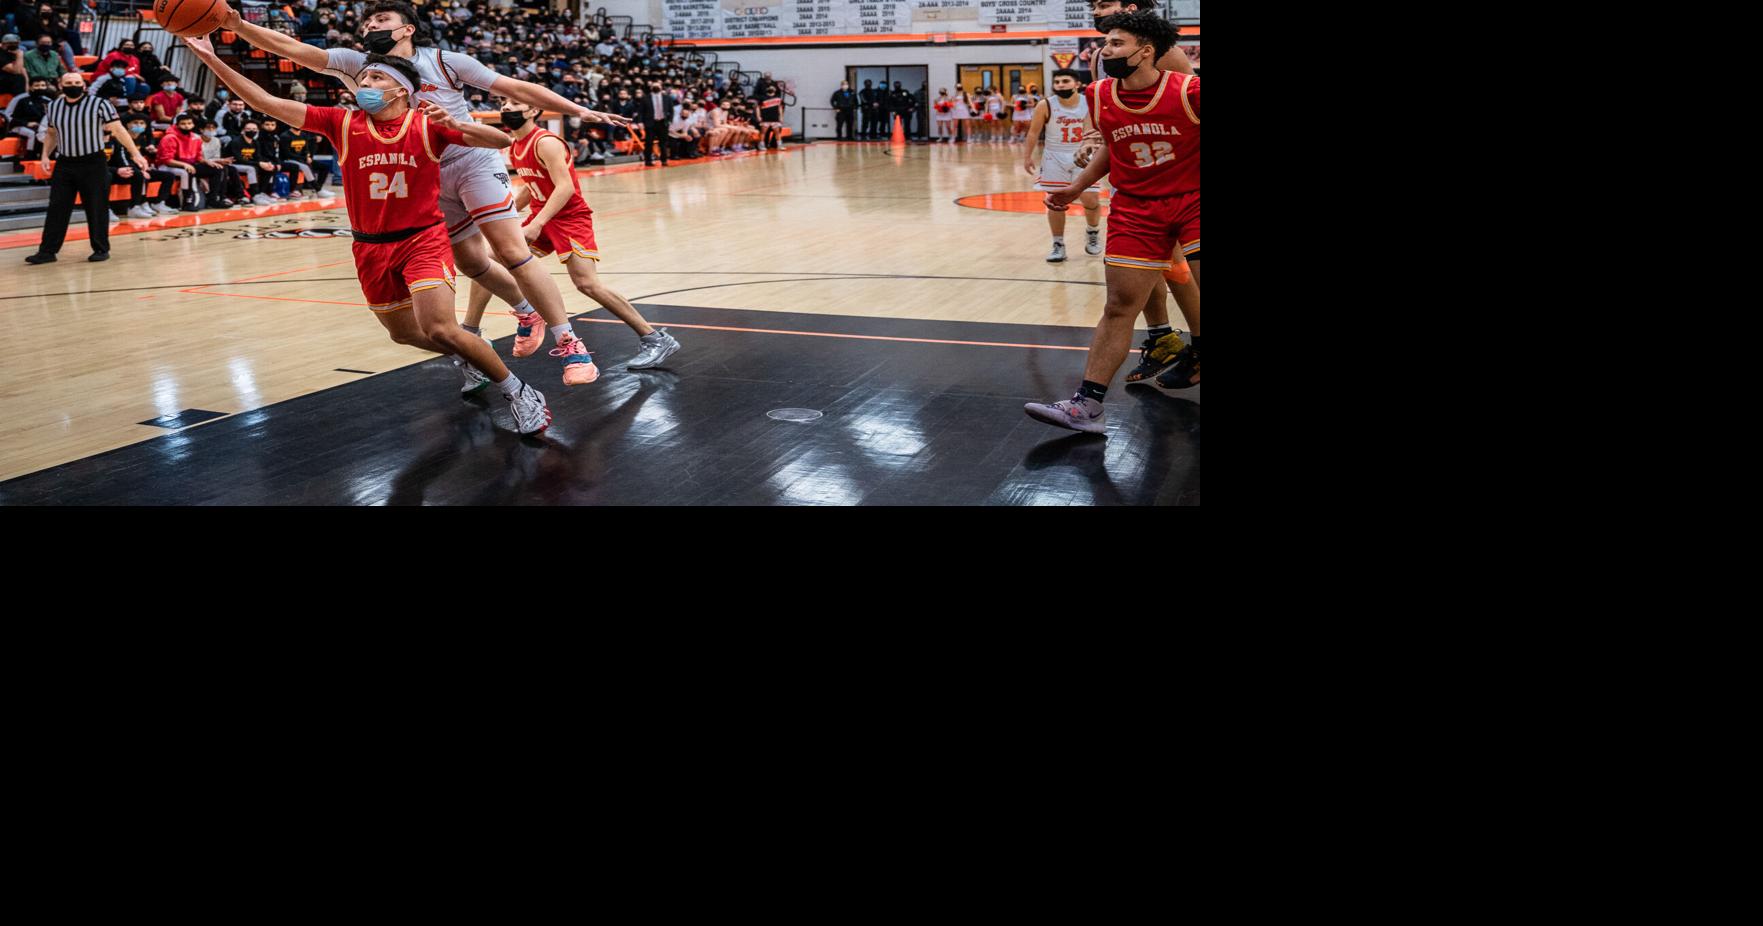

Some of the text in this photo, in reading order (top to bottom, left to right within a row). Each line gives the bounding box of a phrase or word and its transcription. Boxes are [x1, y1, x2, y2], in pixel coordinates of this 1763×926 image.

[1061, 127, 1082, 144] 13
[1112, 122, 1182, 142] ESPANOLA
[358, 152, 418, 170] ESPANLA
[1129, 141, 1176, 168] 32
[368, 170, 408, 200] 24
